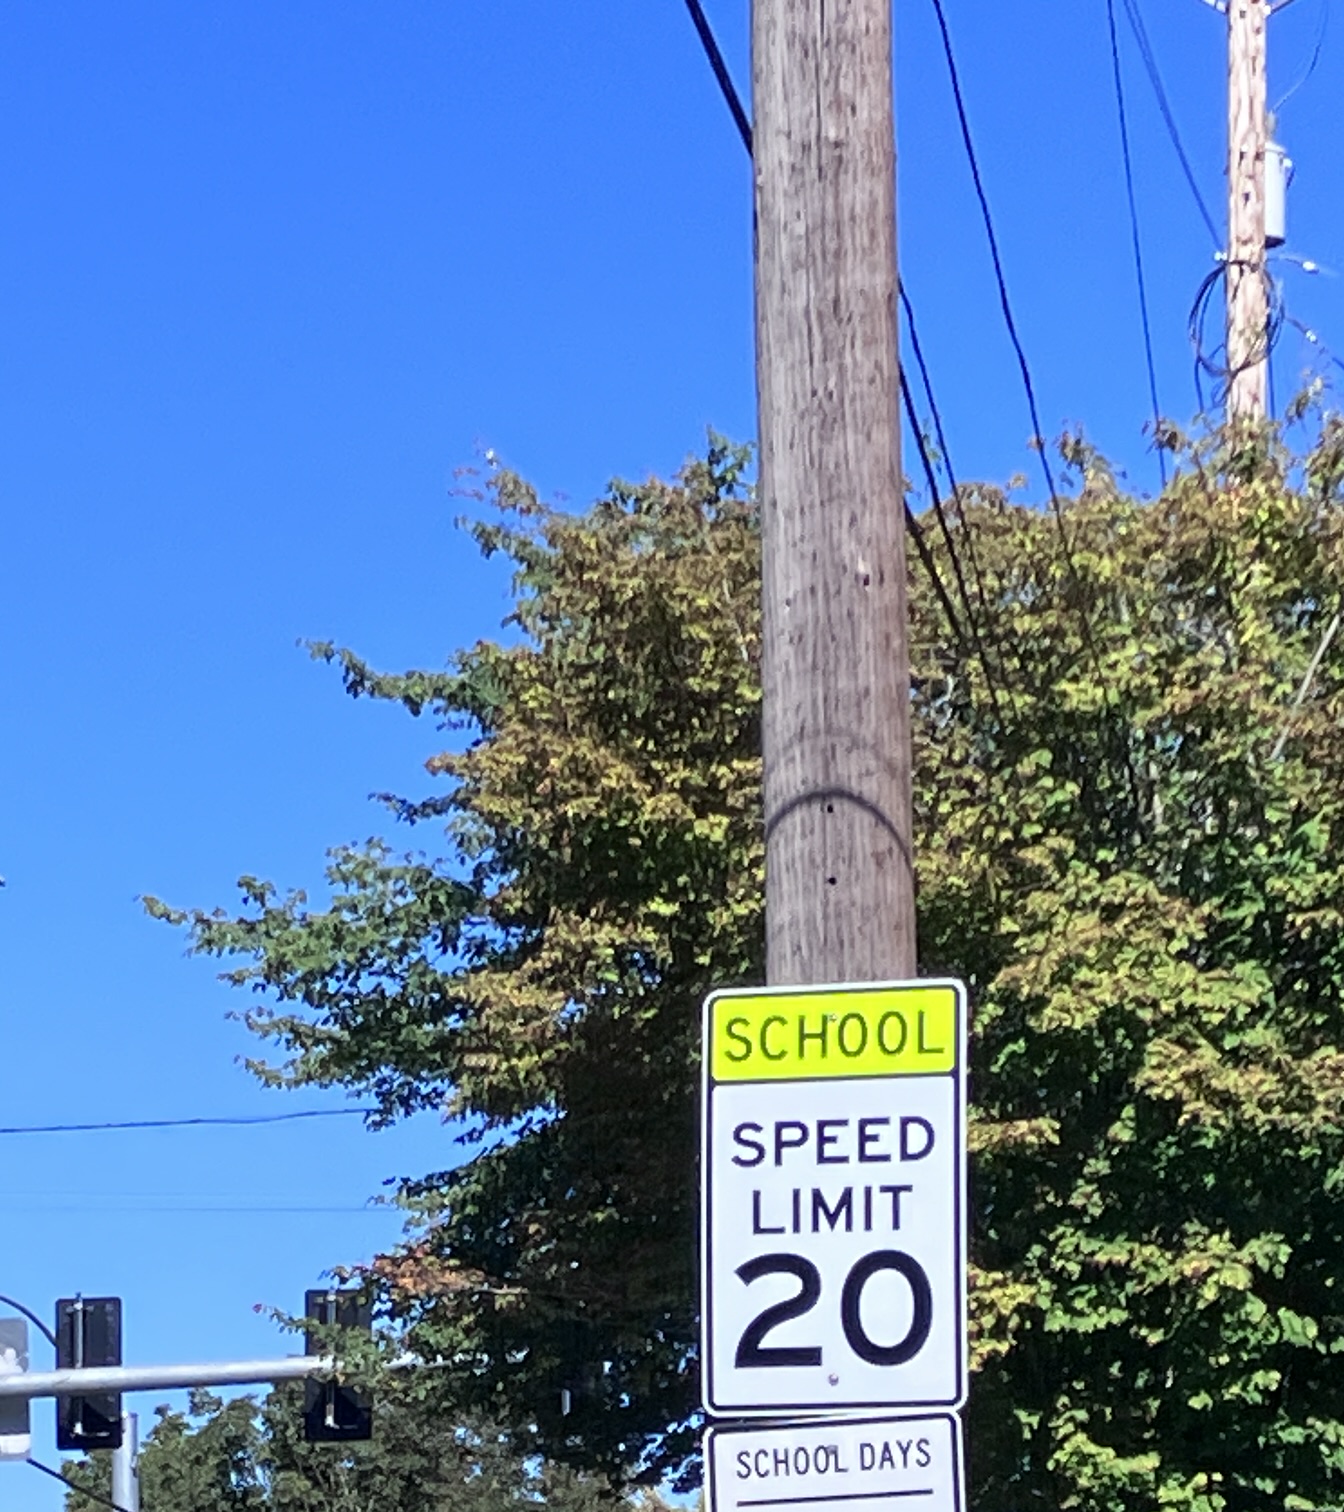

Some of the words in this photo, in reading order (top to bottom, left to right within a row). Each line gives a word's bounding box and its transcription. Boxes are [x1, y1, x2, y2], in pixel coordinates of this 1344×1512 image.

[724, 1009, 945, 1063] SCHOOL
[731, 1116, 936, 1168] SPEED
[752, 1184, 914, 1235] LIMIT
[734, 1249, 934, 1368] 20
[736, 1444, 849, 1480] SCHOOL
[859, 1438, 932, 1471] DAYS
